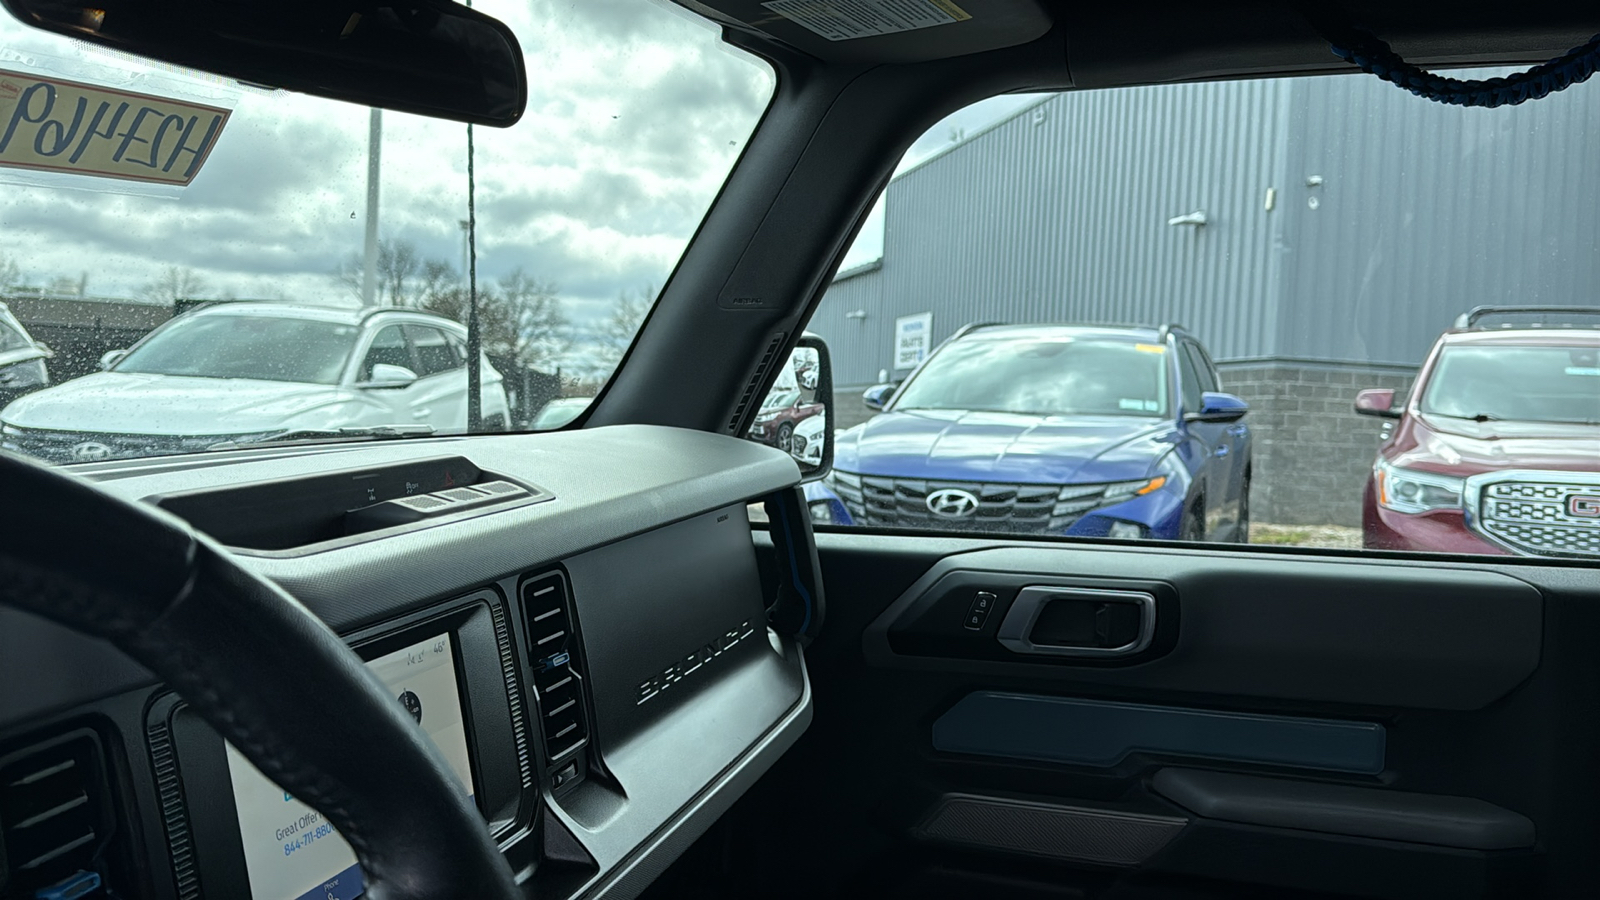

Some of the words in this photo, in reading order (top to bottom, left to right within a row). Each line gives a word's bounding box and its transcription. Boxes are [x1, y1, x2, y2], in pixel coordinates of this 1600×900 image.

[635, 618, 754, 706] BRONCO
[275, 821, 299, 841] Great
[298, 812, 319, 829] Offer
